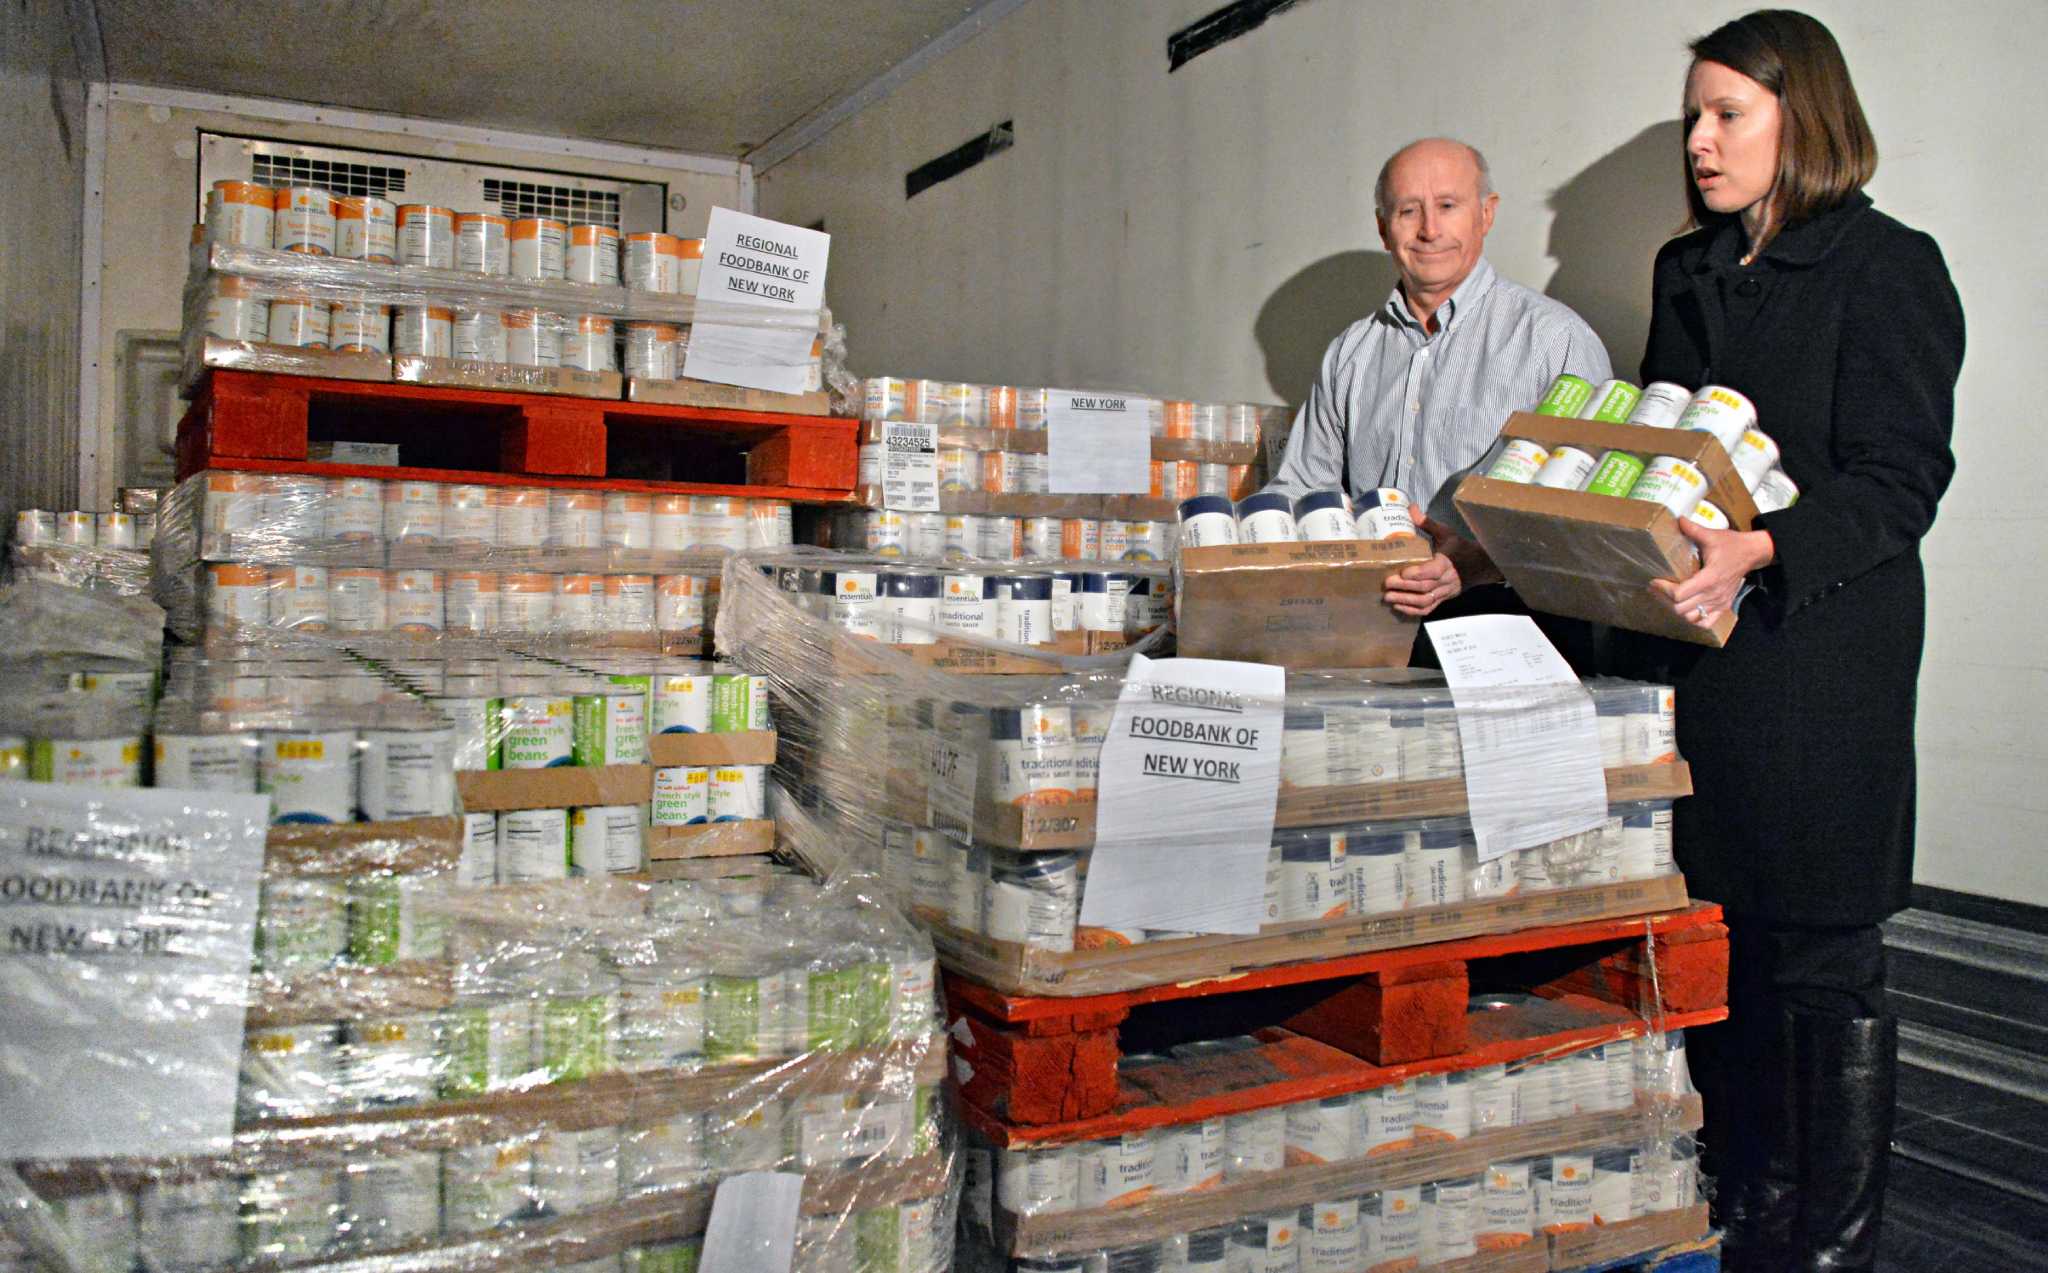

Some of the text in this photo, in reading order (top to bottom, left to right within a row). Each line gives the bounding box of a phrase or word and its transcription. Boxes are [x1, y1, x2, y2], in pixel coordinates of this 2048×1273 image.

[736, 233, 799, 258] REGIONAL
[719, 251, 811, 282] FOODBANK OF
[728, 275, 796, 301] NEW YORK
[1071, 398, 1127, 410] NEW YORK
[885, 436, 930, 448] 43234525
[840, 592, 874, 602] essentials
[939, 610, 984, 621] traditional
[1151, 685, 1244, 710] REGIONAL
[1130, 715, 1260, 746] FOODBANK OF
[508, 735, 548, 749] green
[508, 748, 547, 761] beans
[1144, 753, 1241, 780] NEW YORK
[656, 799, 688, 809] green
[656, 810, 688, 820] beans
[9, 924, 87, 953] NEW
